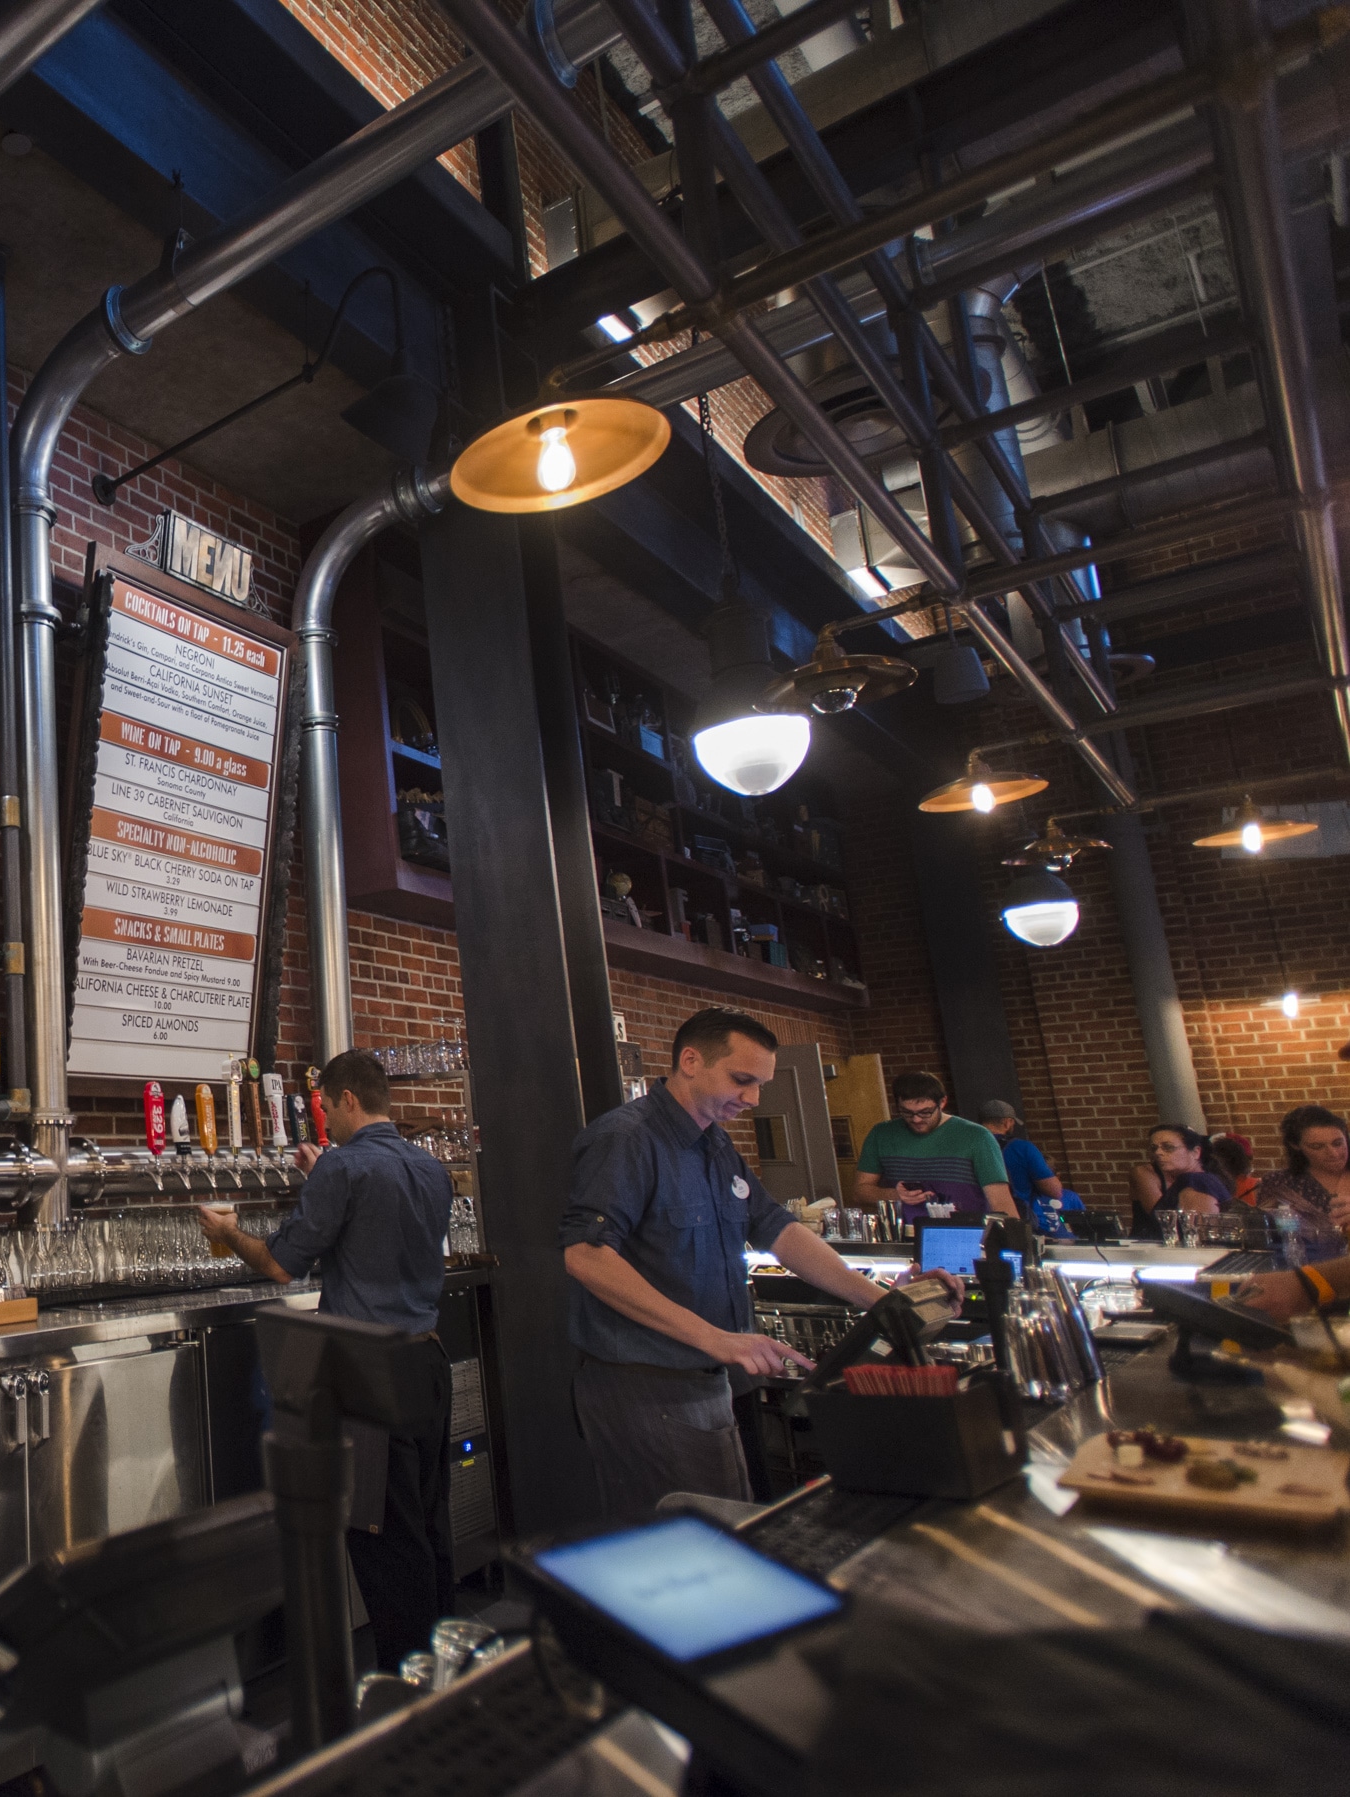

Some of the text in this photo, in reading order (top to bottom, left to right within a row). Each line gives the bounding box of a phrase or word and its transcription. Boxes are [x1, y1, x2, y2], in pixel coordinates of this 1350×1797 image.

[124, 590, 265, 667] COCKTAILS ON TAP 11.25 each
[175, 644, 215, 669] NEGRONI
[149, 664, 233, 705] CALIFORNIA SUNSET
[121, 721, 247, 776] WINE ON TAP 9.00 a glass
[138, 756, 175, 779] FRANCIS
[177, 768, 238, 796] CHARDONNAY
[111, 782, 243, 829] LINE 39 CABERNET SAUVIGNON
[116, 820, 237, 865] SPECIALTY NON-ALCOHOLIC
[134, 853, 162, 871] BLACK
[164, 861, 197, 878] CHERRY
[198, 868, 222, 884] SODA
[224, 874, 238, 887] ON
[240, 877, 254, 891] TAP
[106, 880, 233, 917] WILD STRAWBERRY LEMONADE
[113, 917, 225, 951] SNACKS & SMALL PLATES
[126, 947, 204, 972] BAVARIAN PRETZEL
[75, 973, 250, 1009] ALIFORNIA CHEESE & CHARCUTERIE PLATE
[121, 1013, 199, 1032] SPICED ALMONDS
[271, 1079, 282, 1091] IPA
